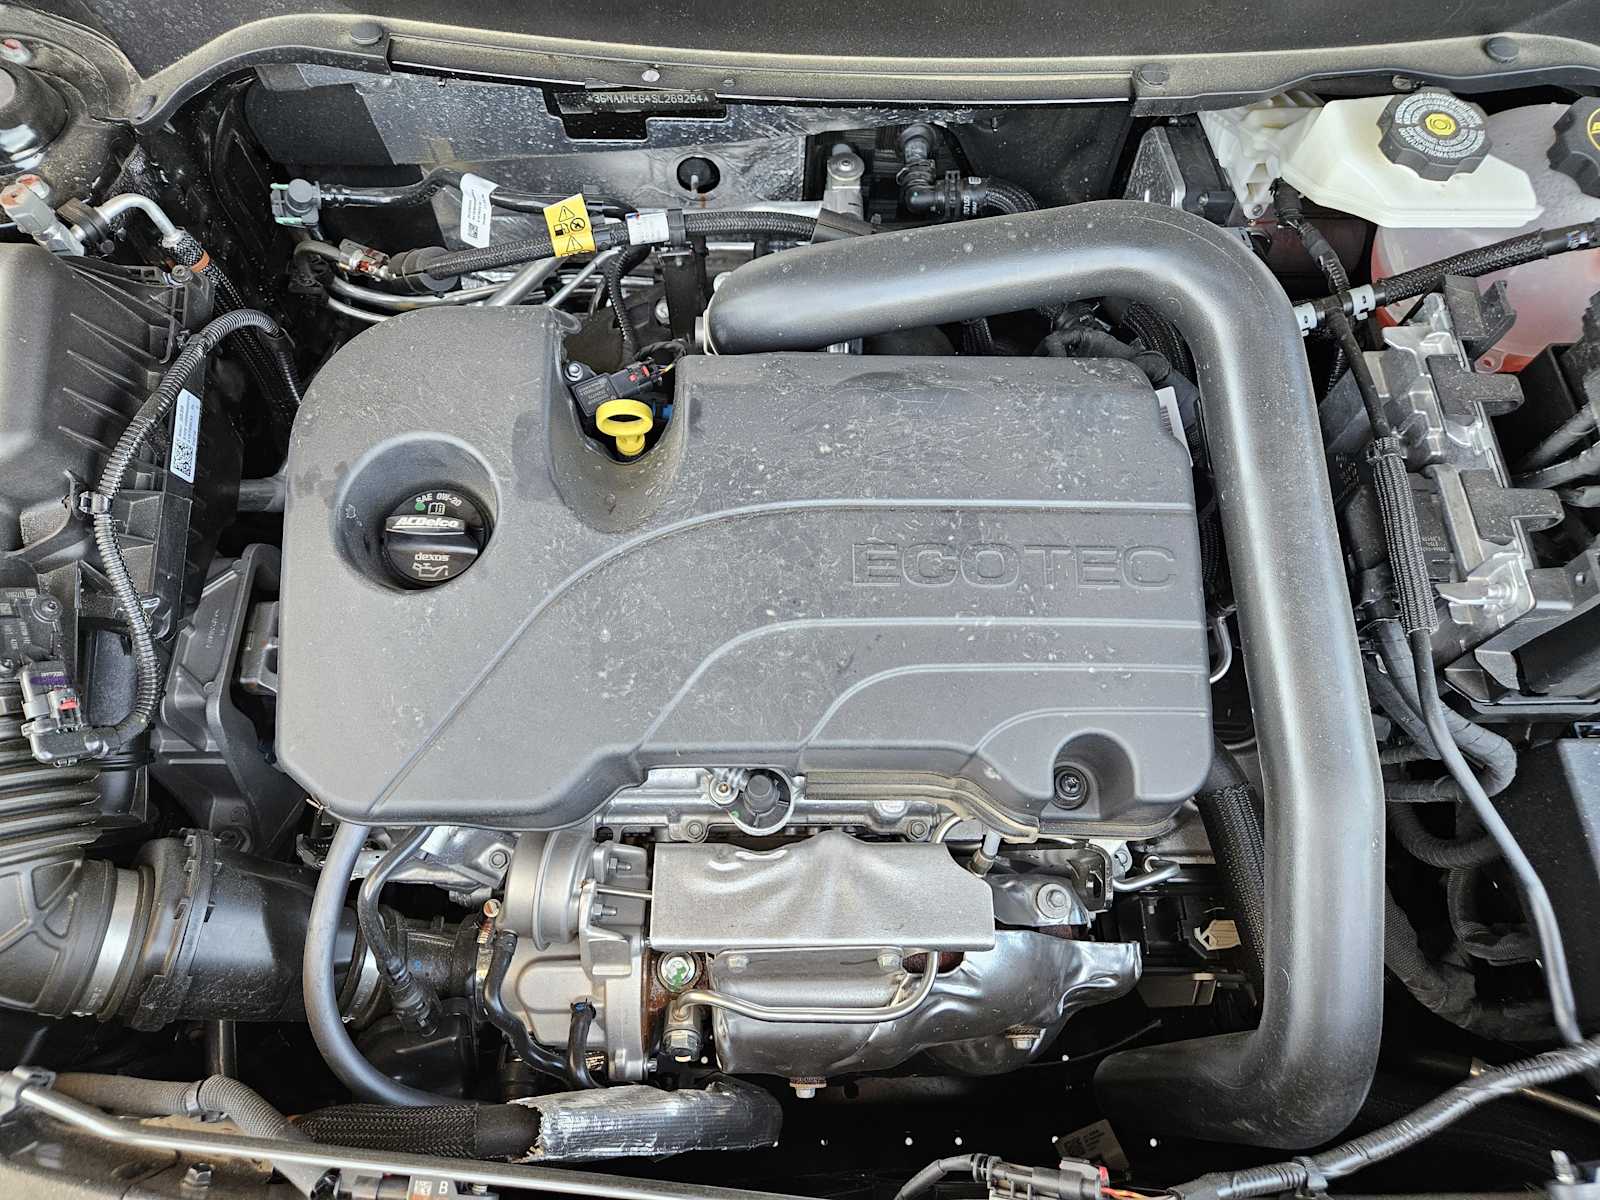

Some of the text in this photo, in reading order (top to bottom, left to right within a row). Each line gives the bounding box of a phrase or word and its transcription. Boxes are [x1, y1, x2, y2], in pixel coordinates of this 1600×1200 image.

[415, 493, 462, 507] SAE 0W-20
[395, 516, 459, 528] ACDelco
[414, 552, 450, 562] dexos
[852, 542, 1177, 591] ECOTEC
[438, 1181, 448, 1194] B
